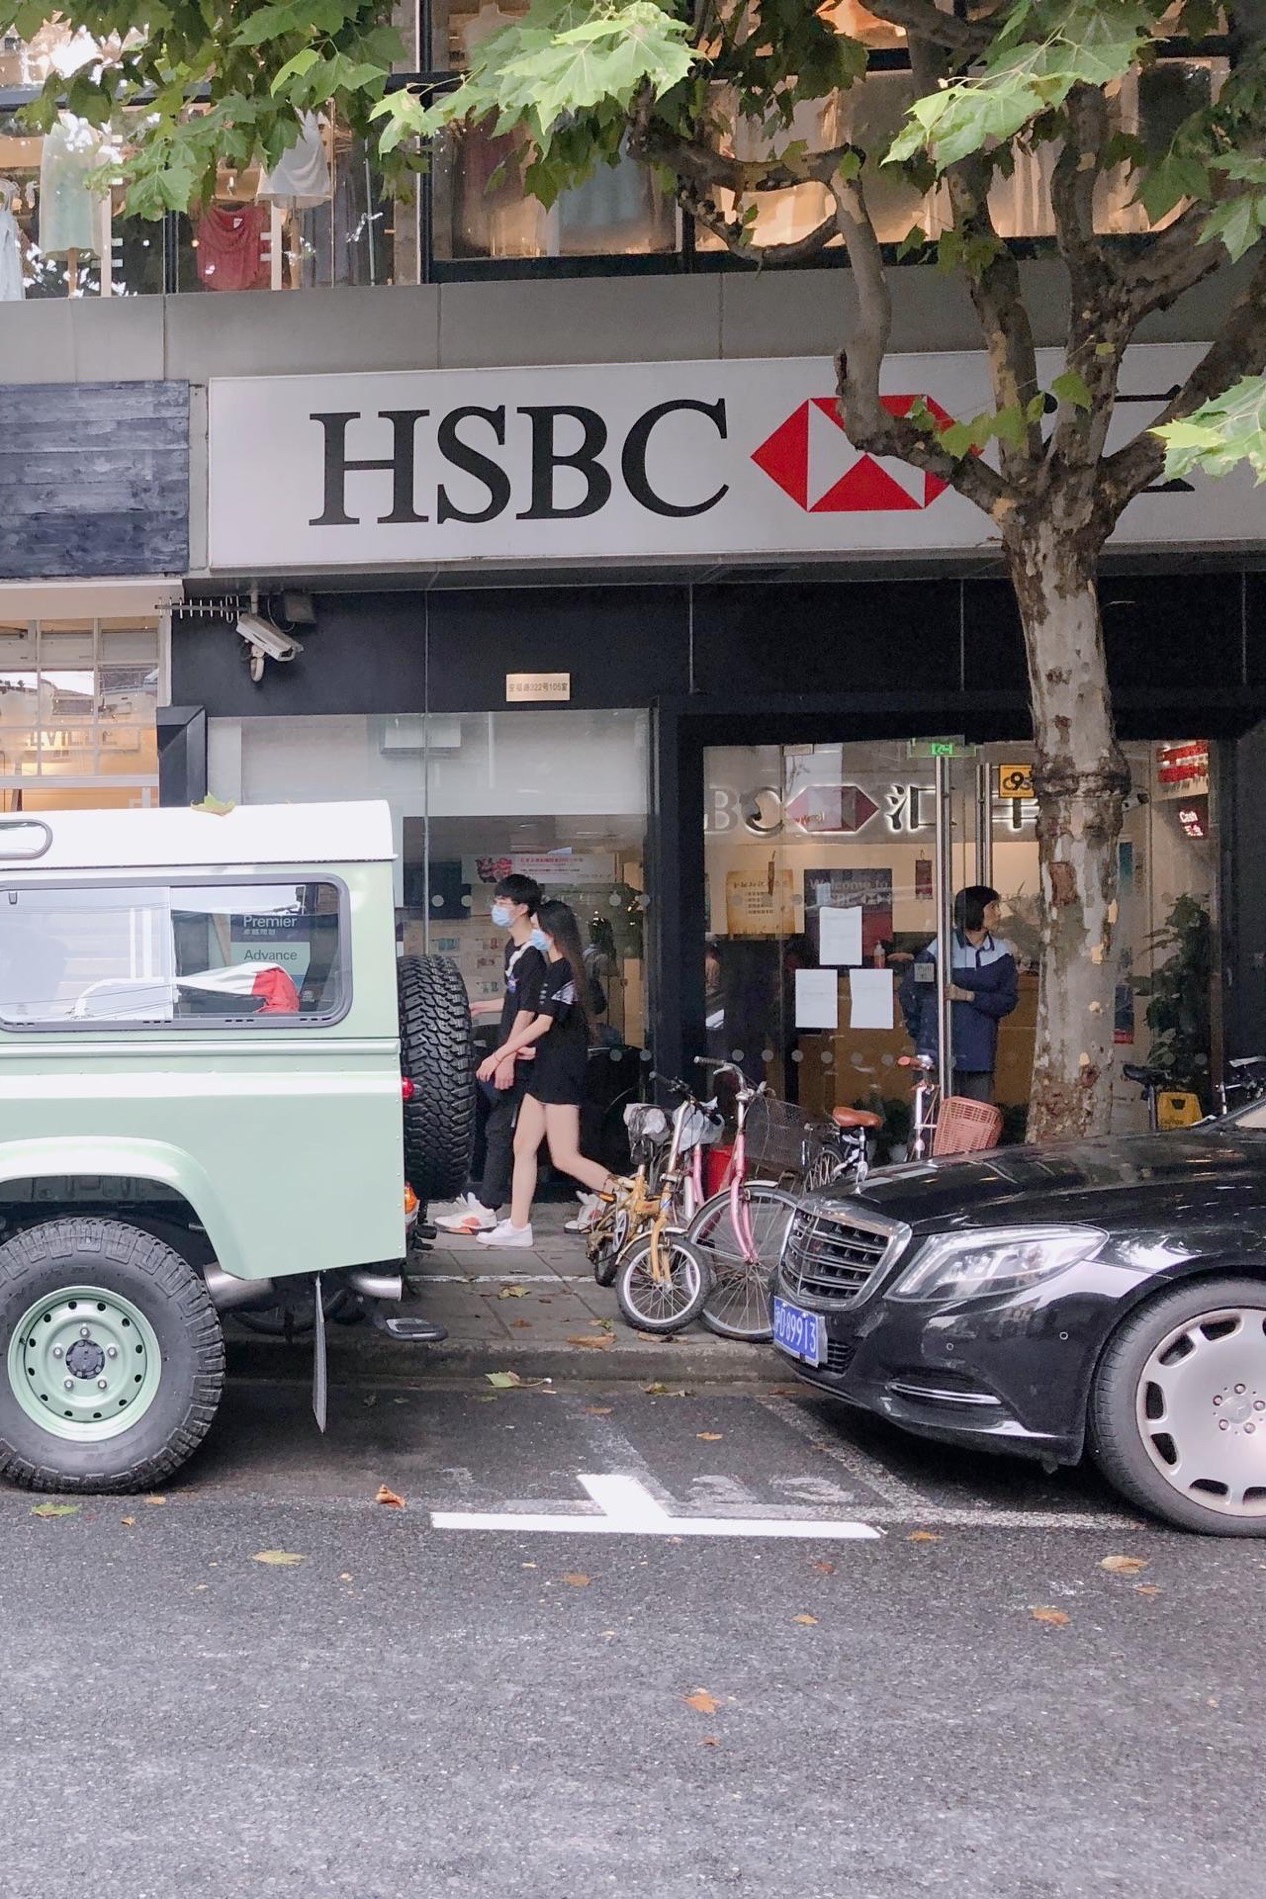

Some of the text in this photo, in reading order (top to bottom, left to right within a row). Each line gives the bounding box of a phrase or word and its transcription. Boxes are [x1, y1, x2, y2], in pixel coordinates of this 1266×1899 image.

[308, 397, 730, 527] HSBC
[243, 915, 298, 928] Premier
[244, 949, 298, 961] Advance
